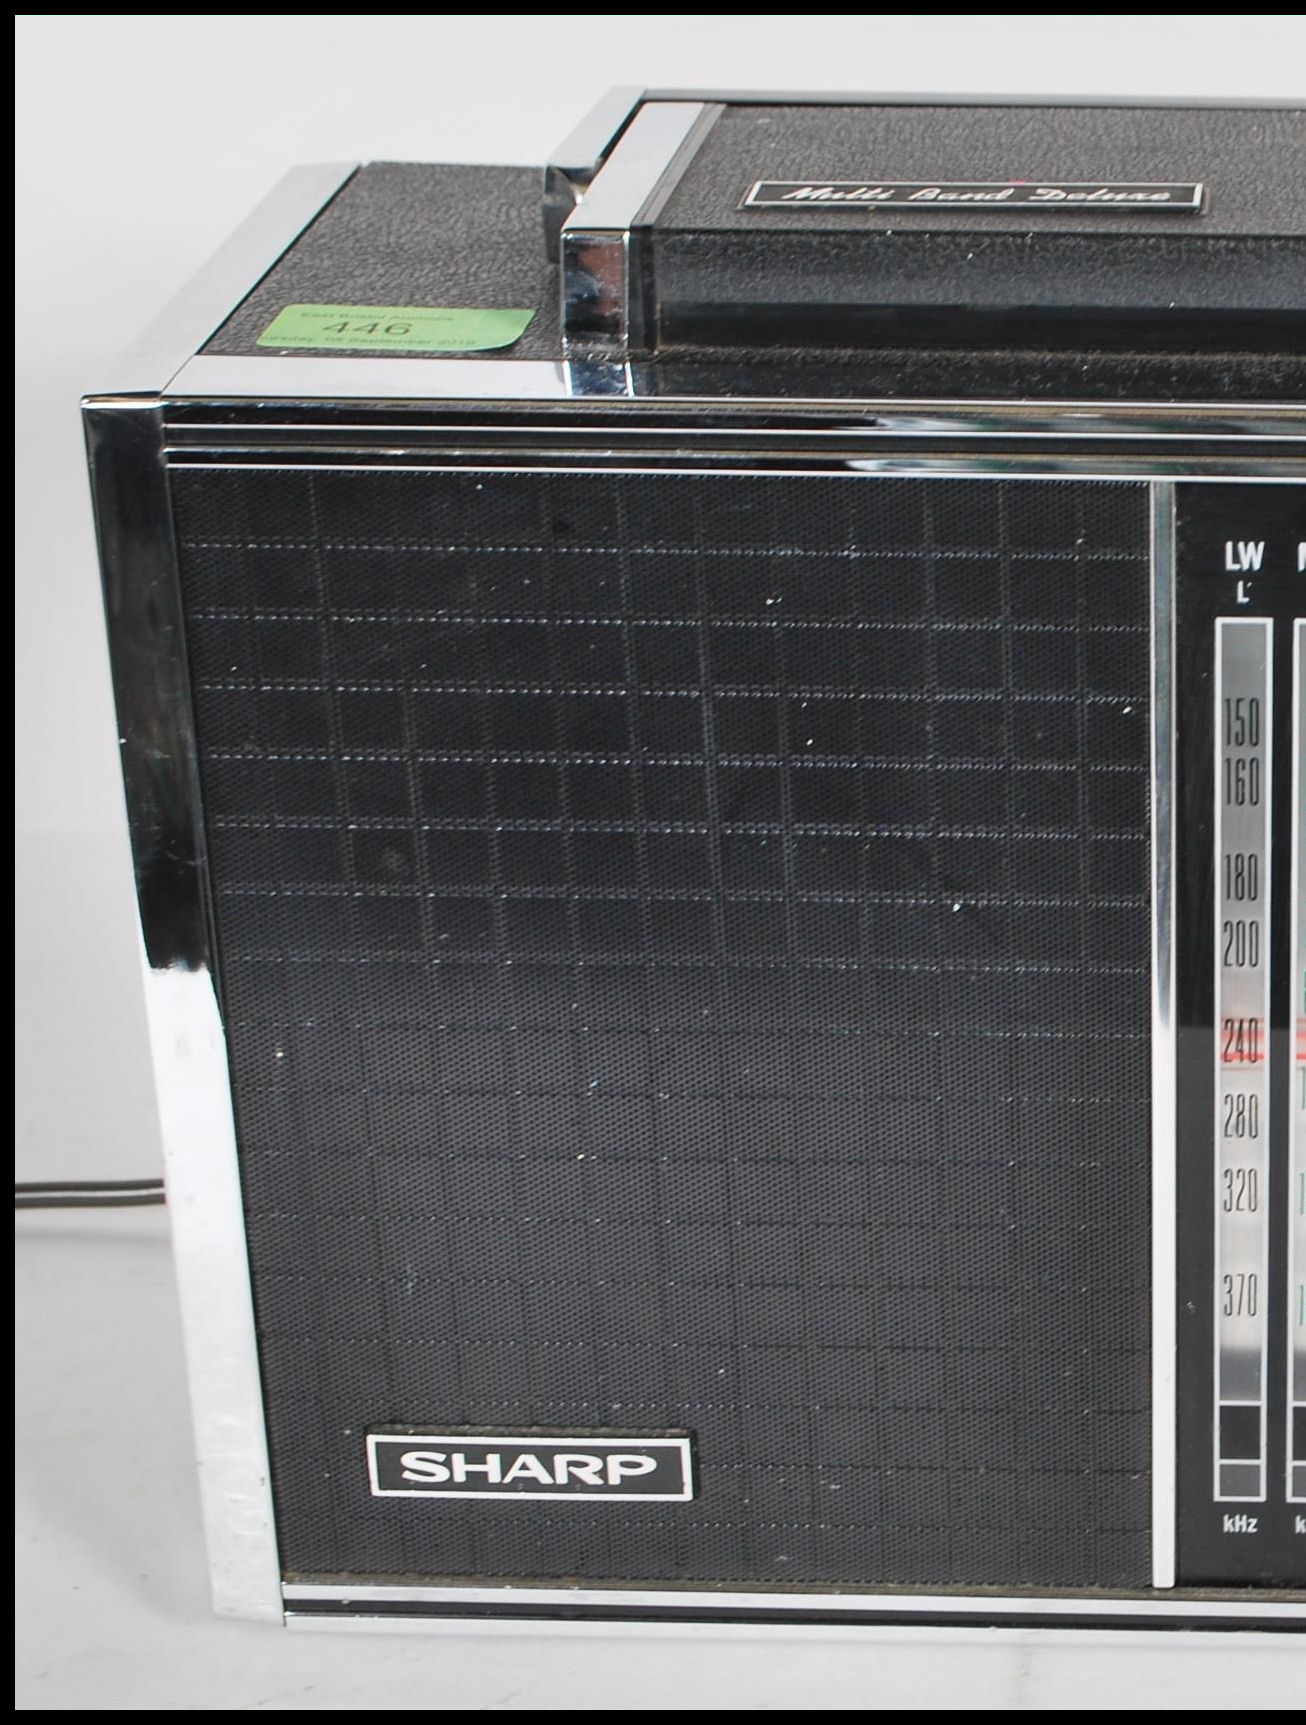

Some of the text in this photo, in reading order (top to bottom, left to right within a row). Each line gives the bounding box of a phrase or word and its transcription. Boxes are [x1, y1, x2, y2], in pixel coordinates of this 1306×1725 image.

[782, 185, 894, 201] Multi
[907, 186, 1015, 202] Band
[322, 321, 414, 336] 446
[1225, 541, 1265, 572] LW
[1225, 697, 1260, 747] 150
[1225, 757, 1260, 806] 160
[1225, 852, 1259, 902] 180
[1223, 919, 1260, 968] 200
[1223, 1017, 1259, 1063] 240
[1223, 1093, 1259, 1139] 280
[1223, 1168, 1258, 1213] 320
[1223, 1273, 1258, 1317] 370
[400, 1450, 658, 1486] SHARP
[1223, 1514, 1259, 1534] kHz
